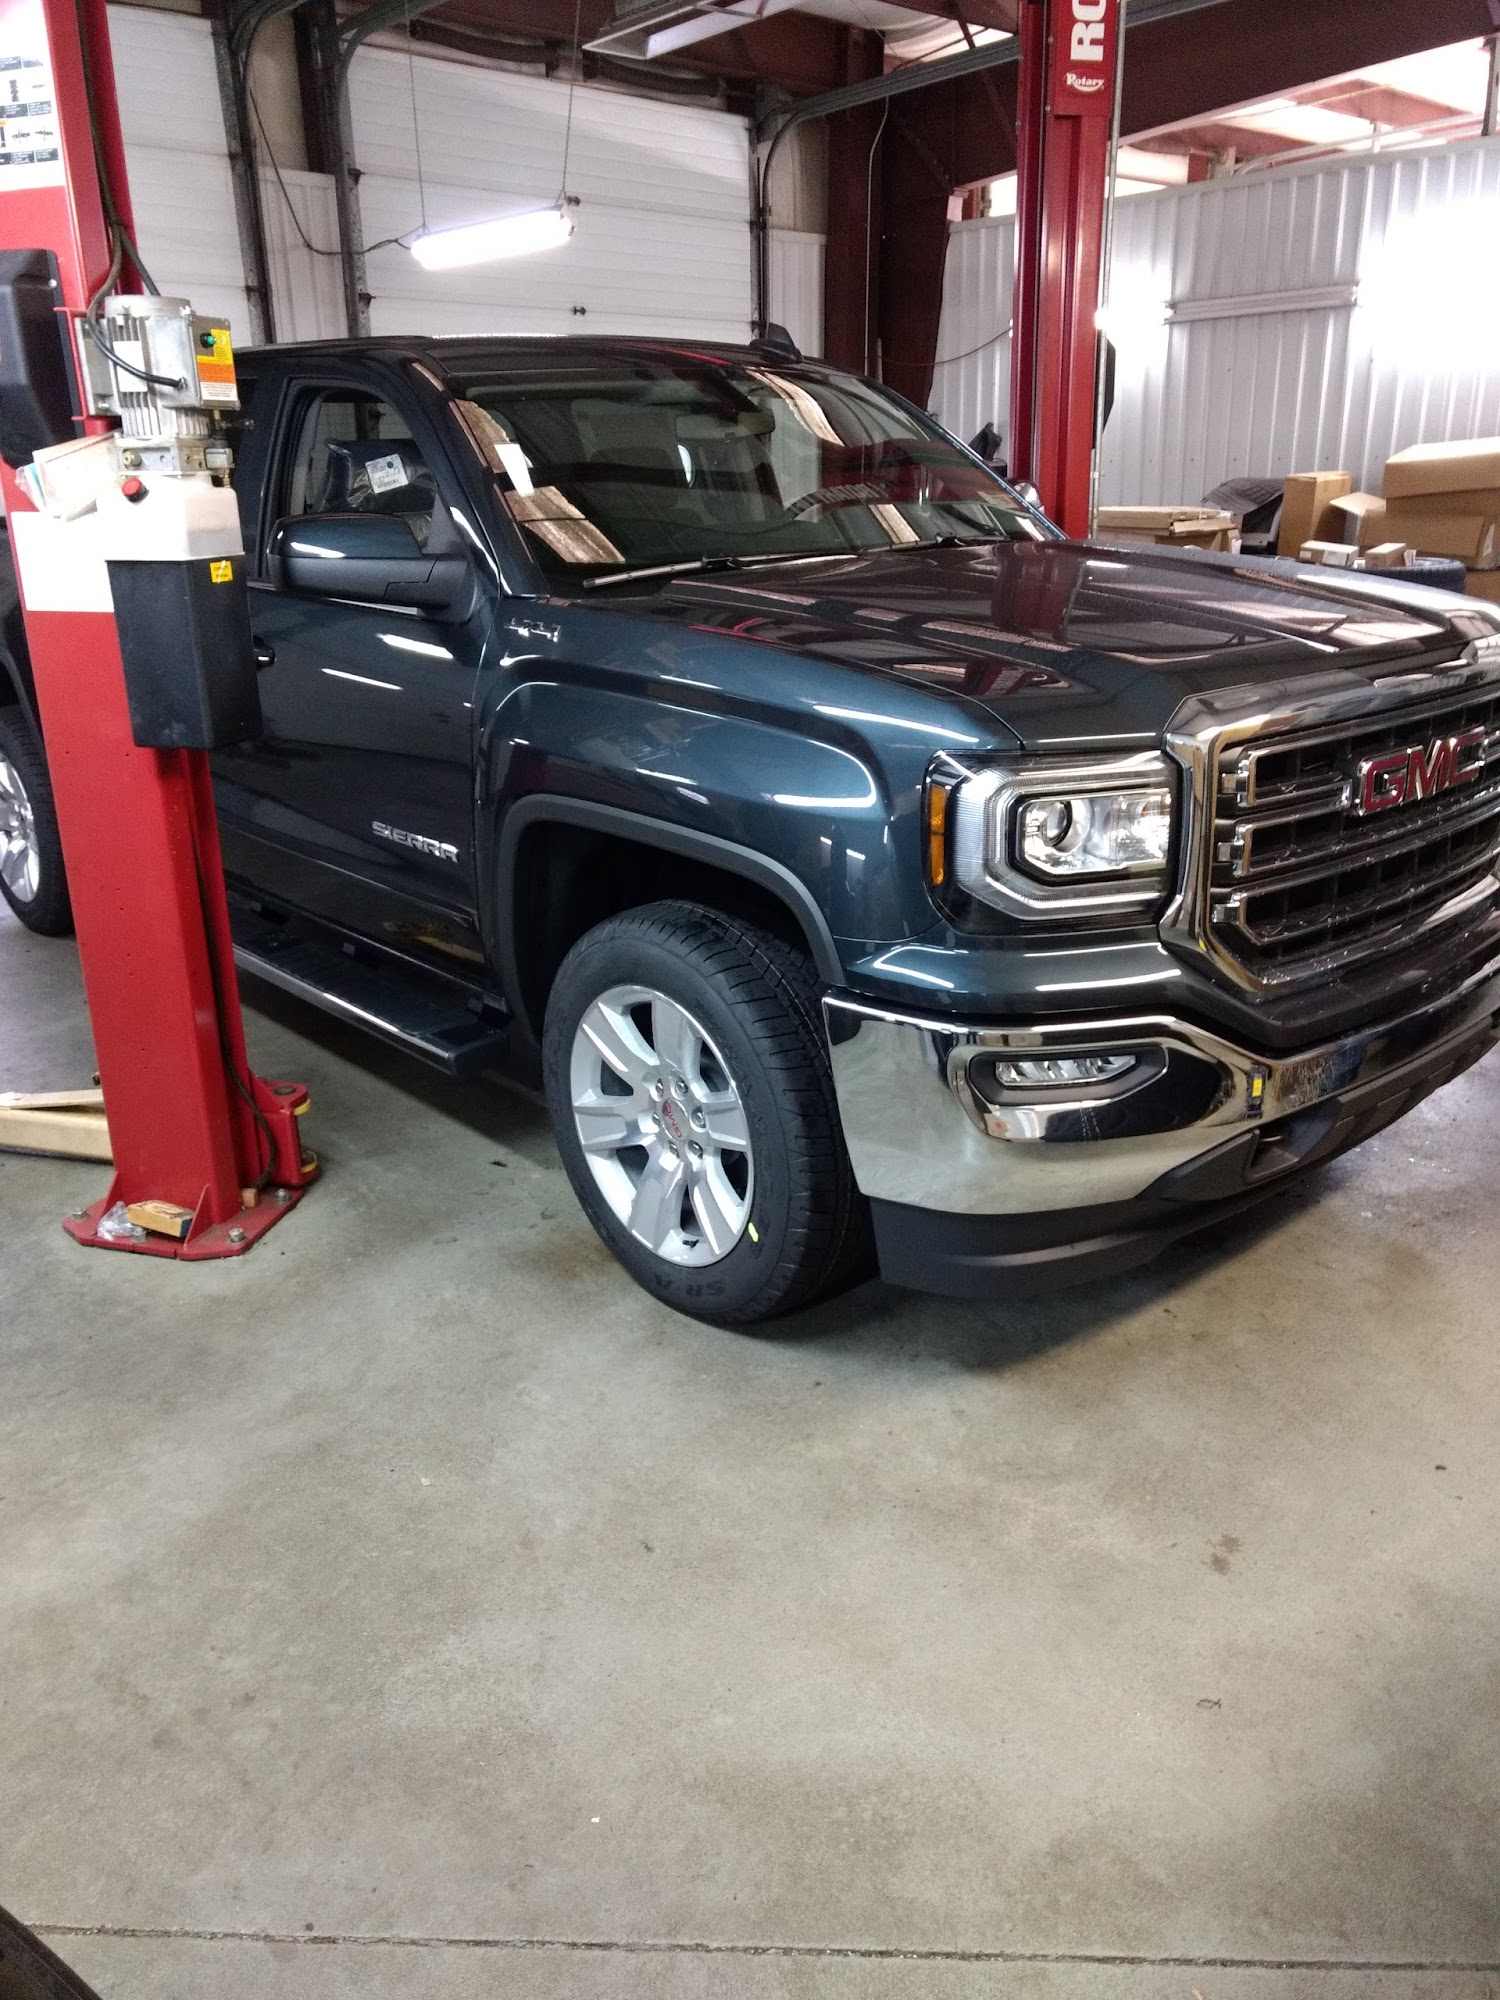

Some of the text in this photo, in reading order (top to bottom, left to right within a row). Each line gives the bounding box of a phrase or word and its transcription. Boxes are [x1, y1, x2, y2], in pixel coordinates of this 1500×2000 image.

[1066, 72, 1104, 92] Rotary
[1357, 725, 1486, 817] GMC
[372, 821, 459, 863] SIERRA
